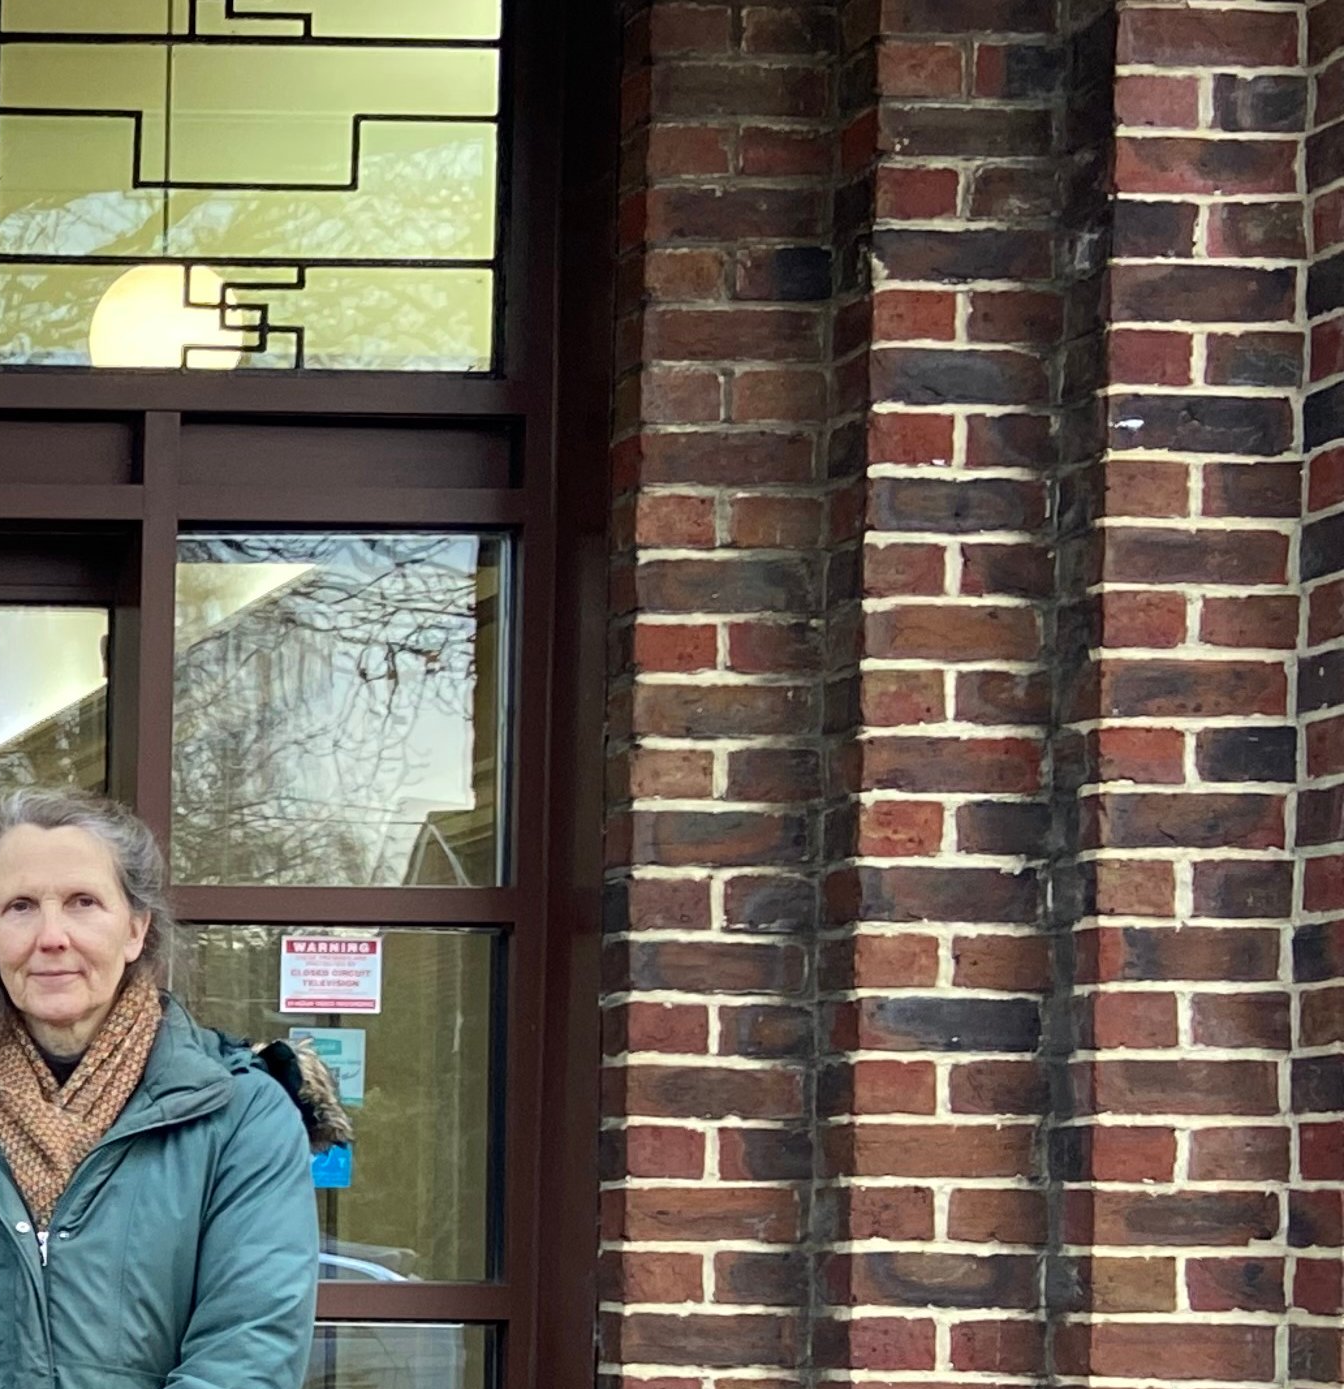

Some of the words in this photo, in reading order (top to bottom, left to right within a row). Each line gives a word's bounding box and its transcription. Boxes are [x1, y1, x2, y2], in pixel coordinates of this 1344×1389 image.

[292, 942, 370, 953] WARNING
[290, 969, 329, 978] CLOSED
[331, 969, 371, 978] CIRCUIT
[302, 979, 360, 988] TELEVISION
